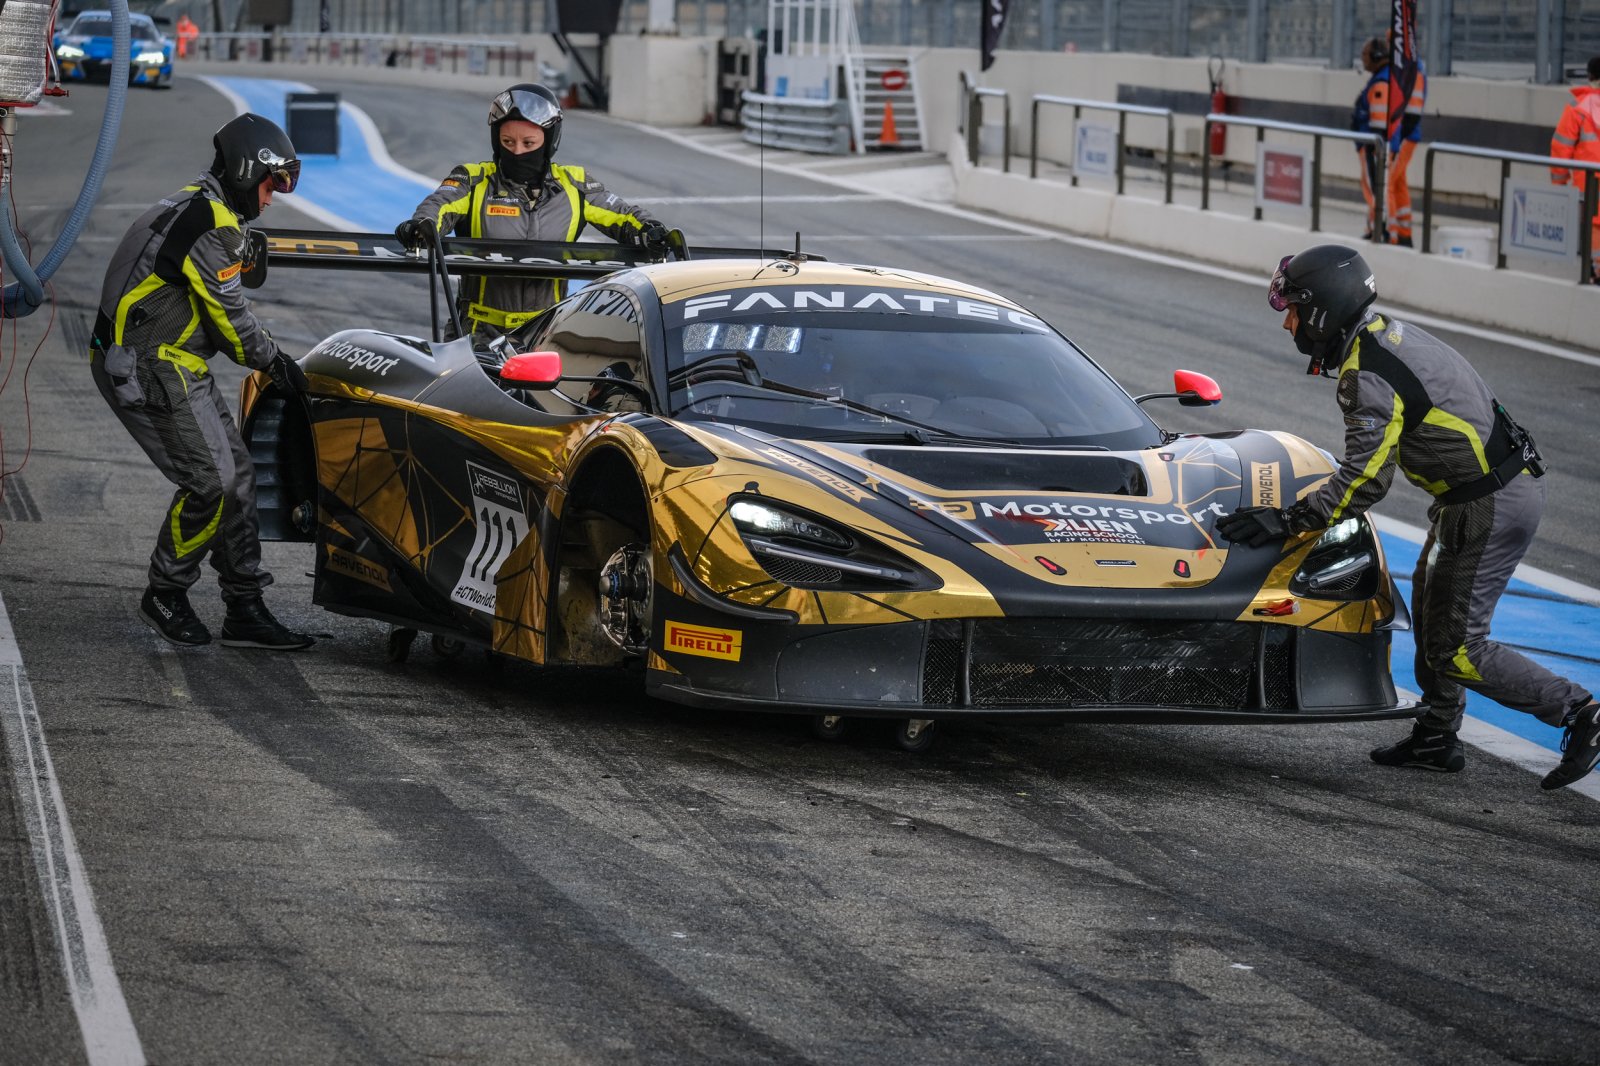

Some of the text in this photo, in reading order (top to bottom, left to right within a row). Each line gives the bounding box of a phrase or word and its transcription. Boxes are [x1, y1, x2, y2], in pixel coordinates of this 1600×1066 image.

[684, 291, 1051, 333] FANATEC
[1259, 464, 1274, 507] RAVENOL
[979, 501, 1229, 526] Motorsport
[469, 506, 518, 585] 111
[1079, 537, 1147, 545] MOTORSPORT
[1093, 531, 1143, 540] SCHOOL
[331, 552, 388, 585] RAVENOL
[670, 626, 734, 654] PIRELLI
